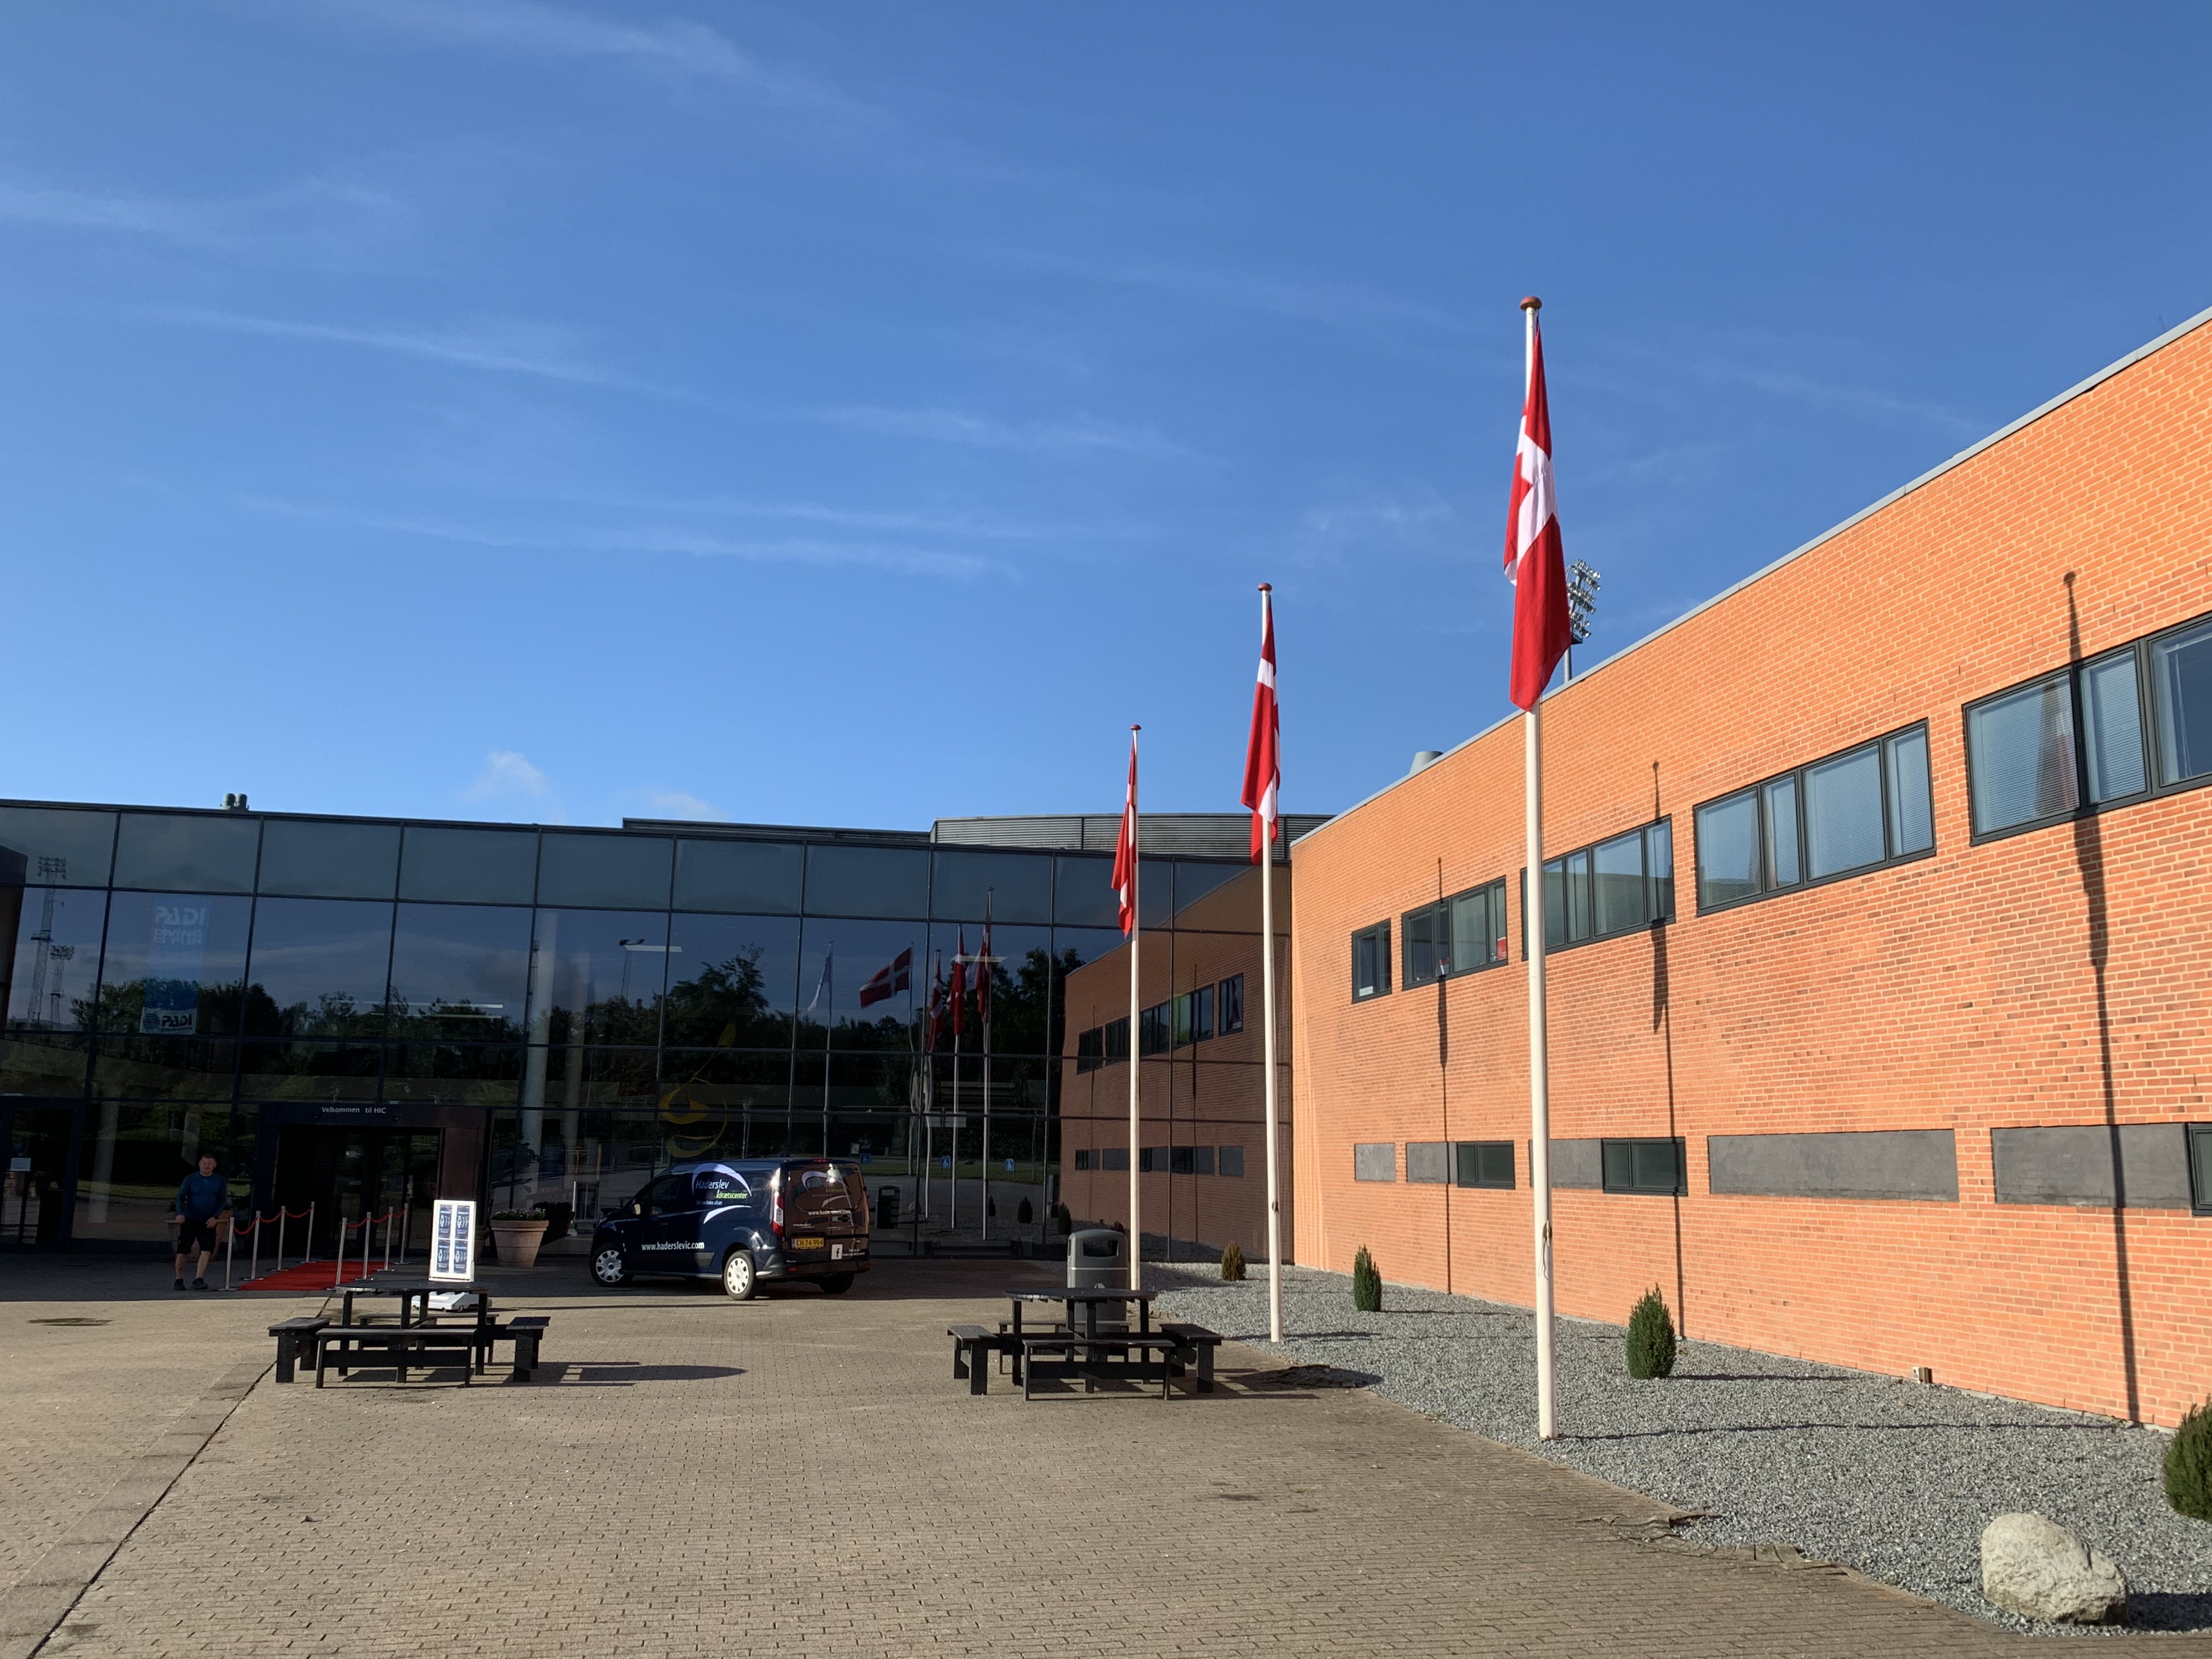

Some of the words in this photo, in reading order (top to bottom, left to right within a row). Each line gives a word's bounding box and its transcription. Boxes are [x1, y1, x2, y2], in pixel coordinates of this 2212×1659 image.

[155, 906, 206, 926] PADI
[154, 928, 202, 937] DIVING
[153, 936, 166, 944] IS
[172, 936, 202, 945] FUN
[161, 1014, 192, 1026] PADI
[695, 1179, 730, 1189] Haderslev
[716, 1189, 748, 1199] Idrætscenter
[641, 1240, 705, 1251] www.haderslevic.com
